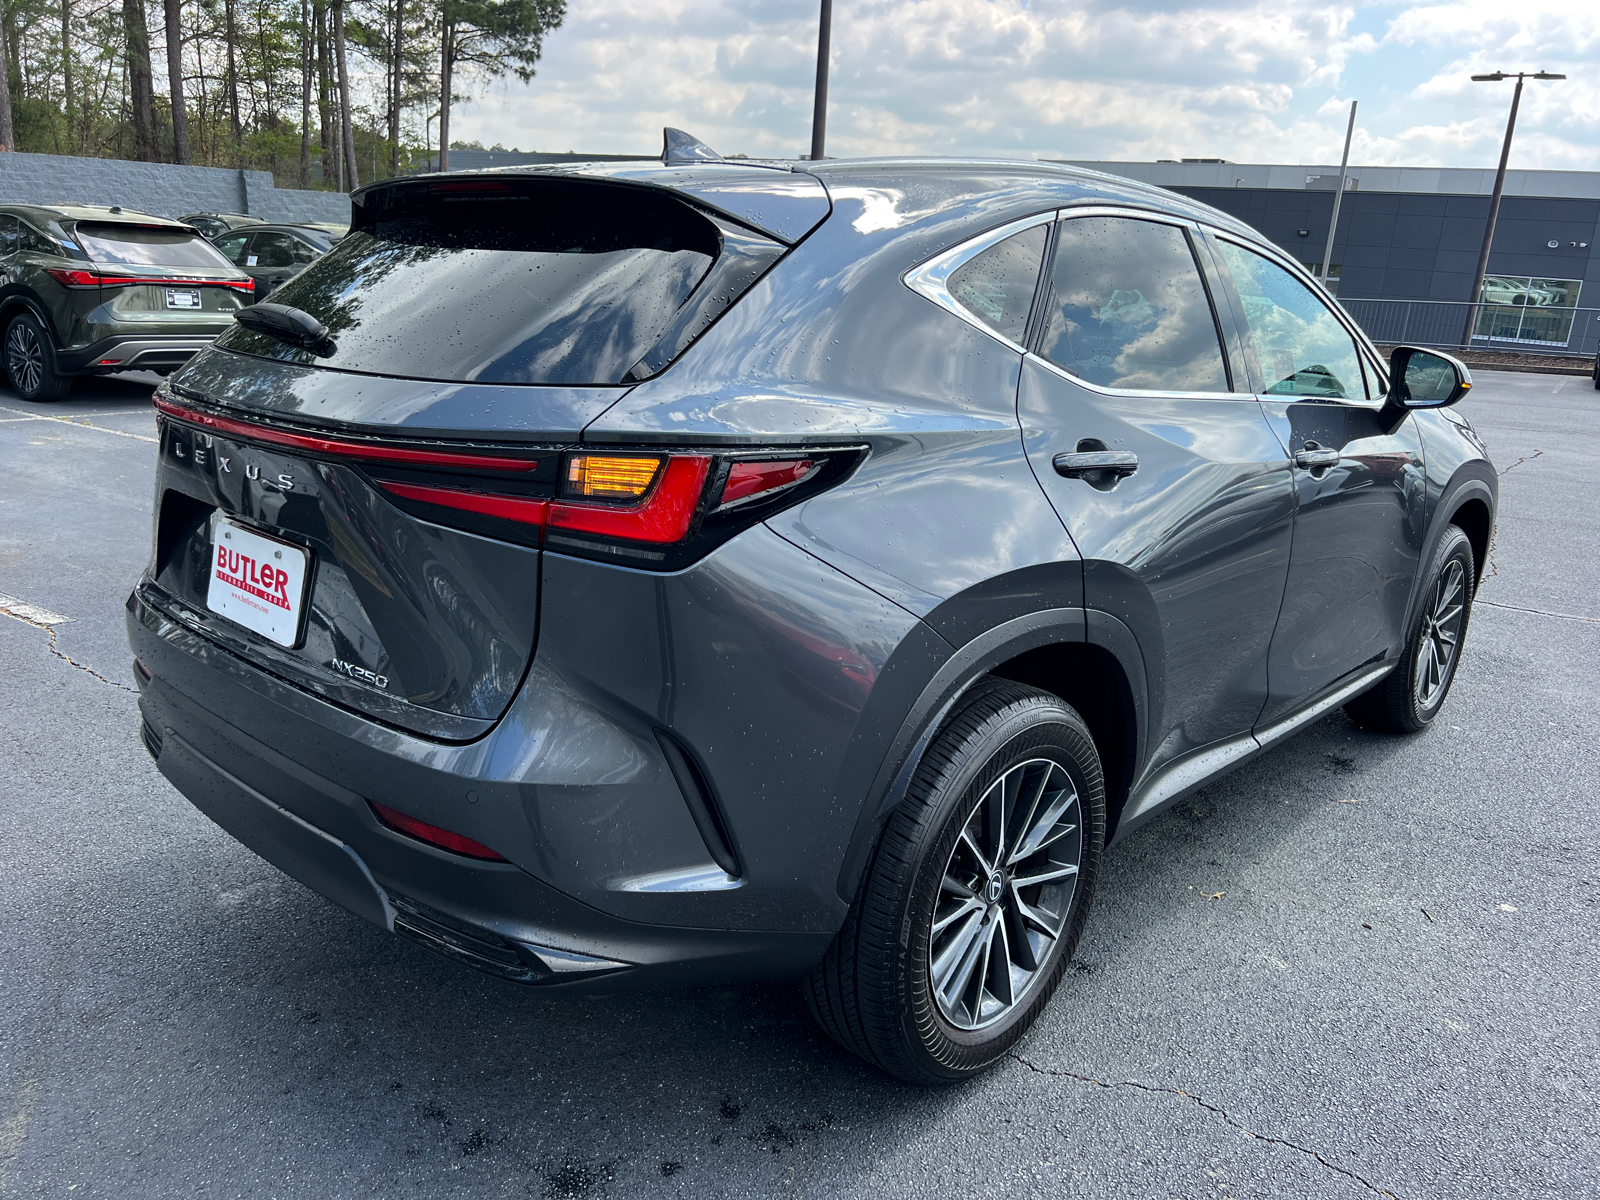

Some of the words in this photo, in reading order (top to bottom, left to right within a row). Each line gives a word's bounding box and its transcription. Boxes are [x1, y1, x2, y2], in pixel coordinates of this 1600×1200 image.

[175, 442, 294, 490] LEXUS
[216, 570, 258, 595] AUTOMOTIVE
[264, 592, 289, 609] GROUP
[231, 591, 269, 615] www.butlercars.com
[332, 657, 389, 690] NX250
[898, 952, 906, 1004] ALENZA
